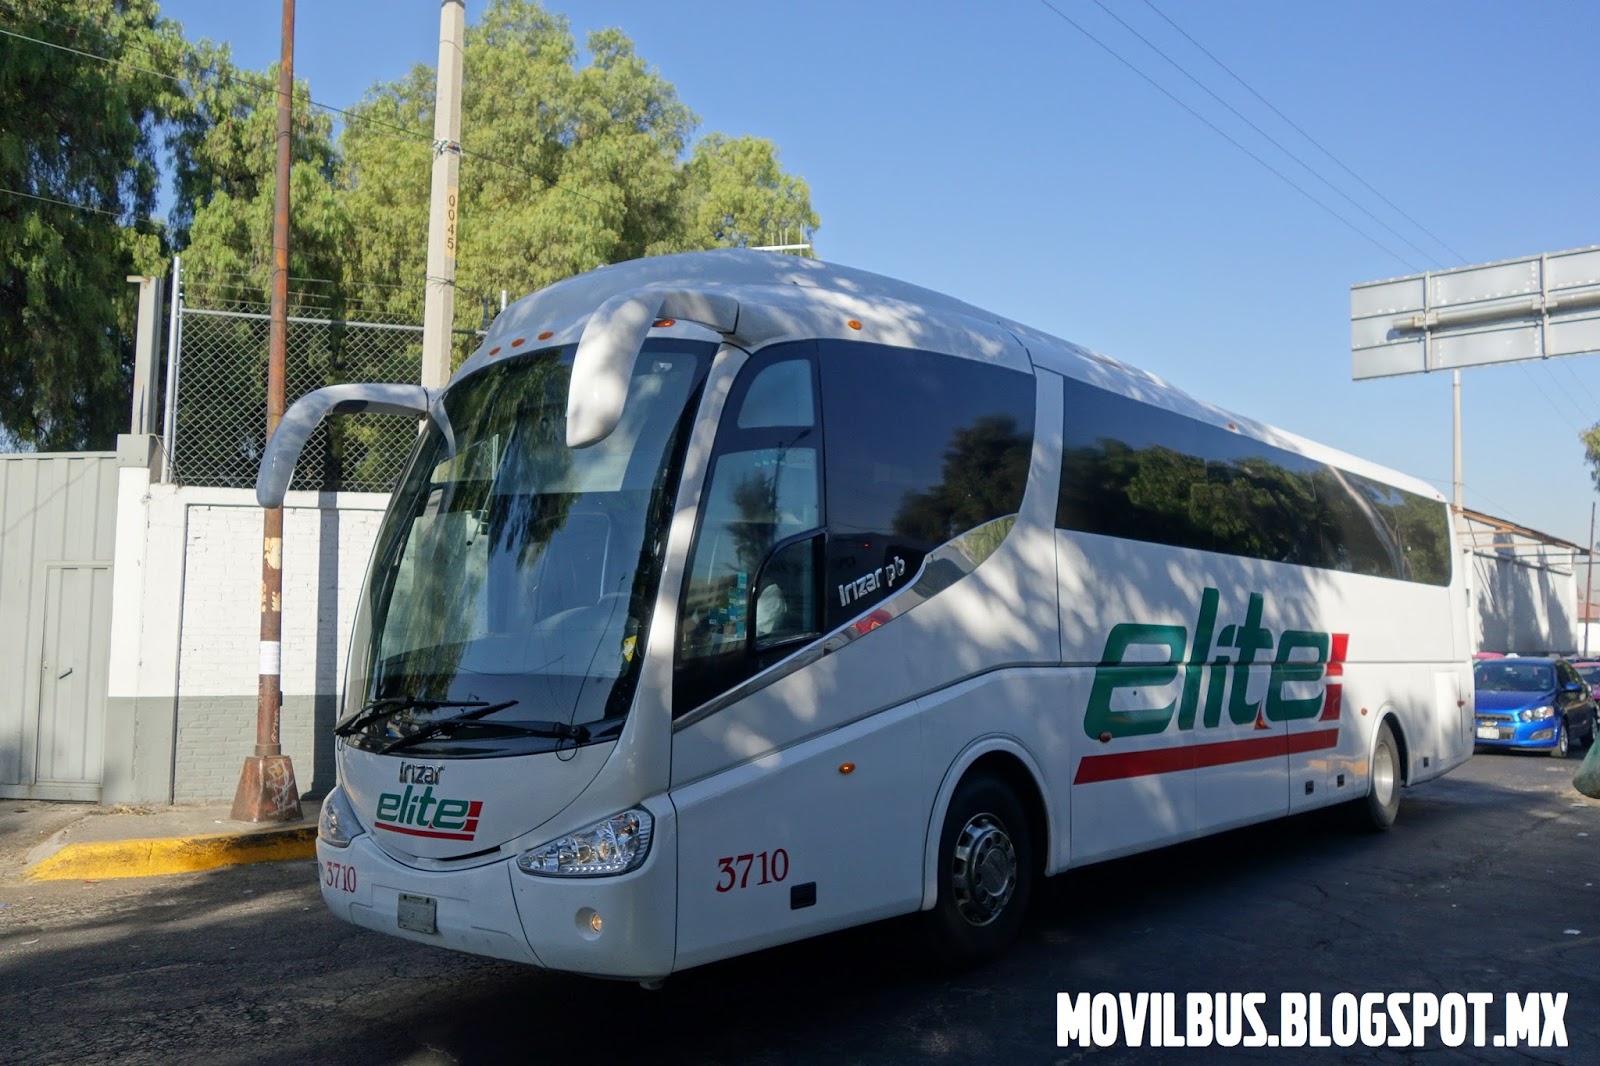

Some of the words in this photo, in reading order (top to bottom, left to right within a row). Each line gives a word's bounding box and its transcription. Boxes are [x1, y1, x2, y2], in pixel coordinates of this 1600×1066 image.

[447, 195, 455, 249] 0045
[838, 568, 882, 607] Irizar
[885, 556, 905, 587] pb
[1083, 587, 1330, 740] elite
[376, 784, 470, 830] elite
[326, 861, 357, 893] 3710
[716, 848, 789, 893] 3710
